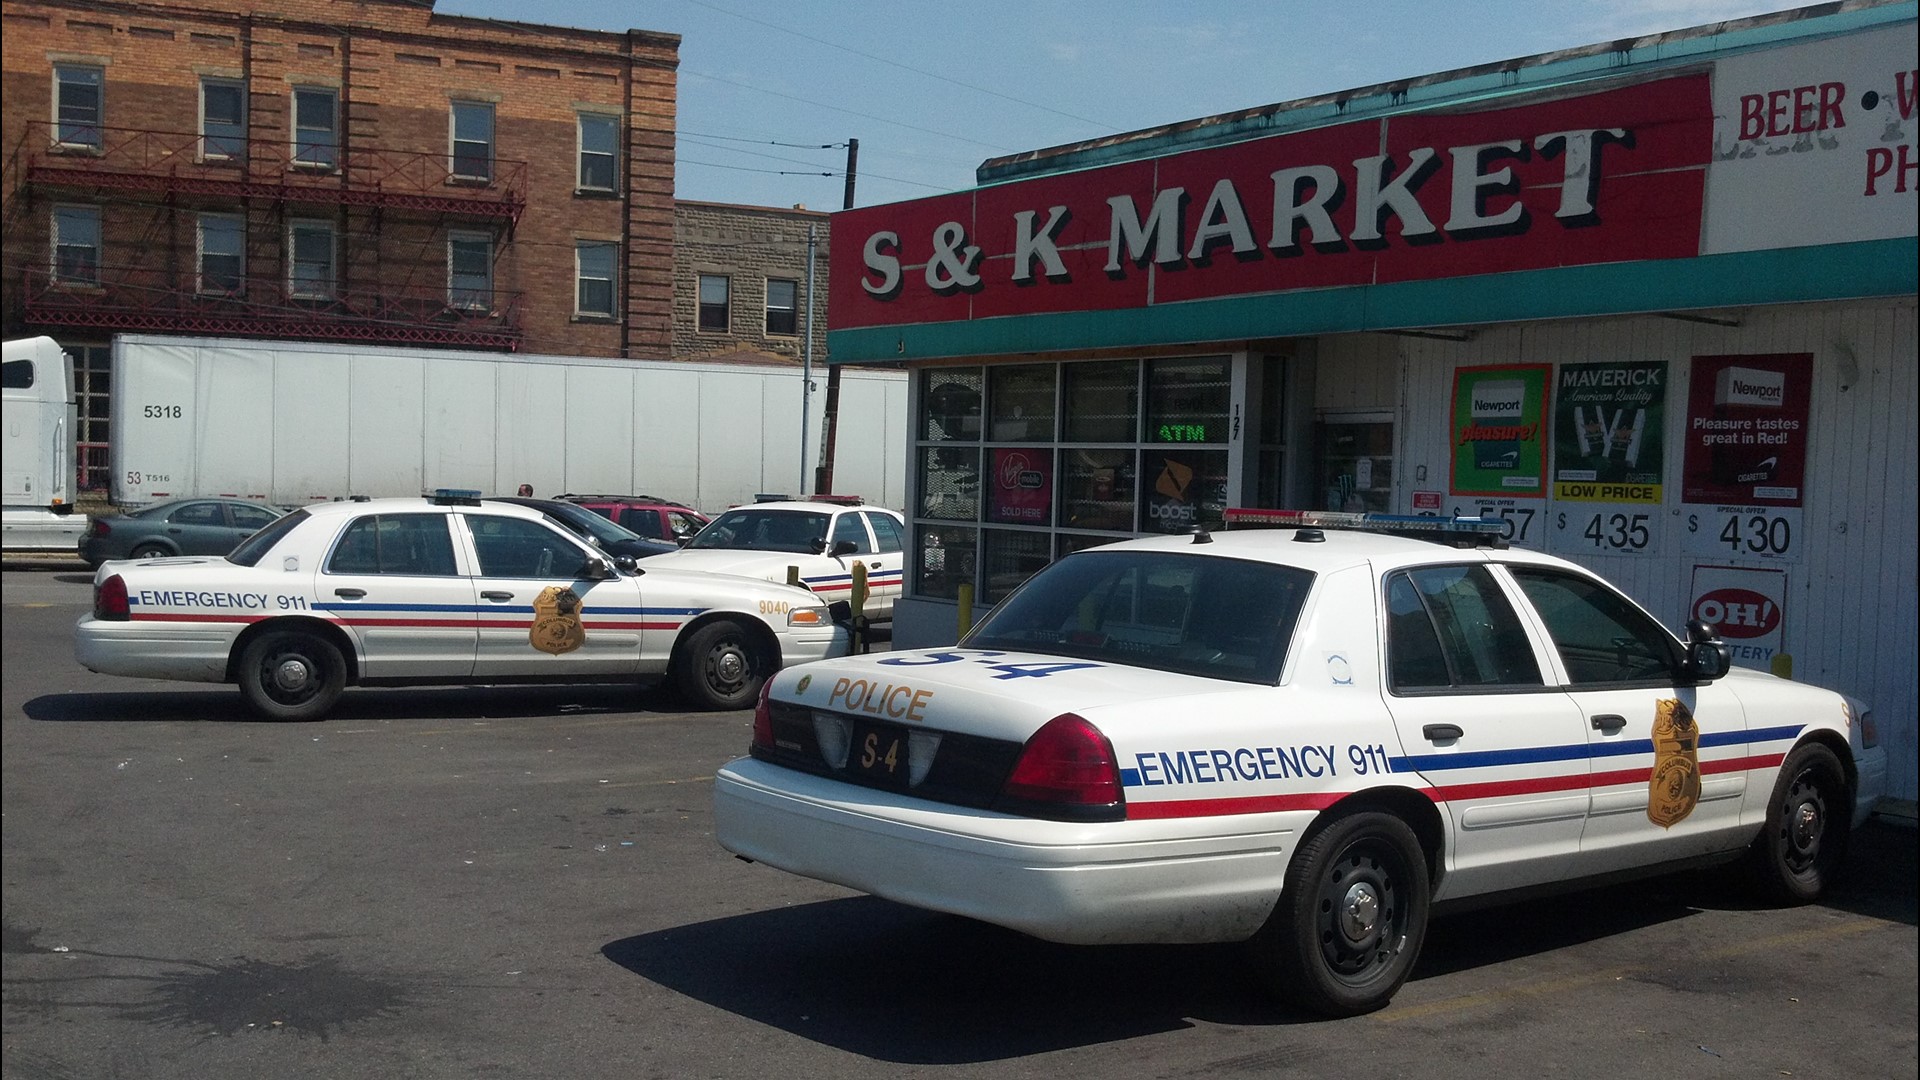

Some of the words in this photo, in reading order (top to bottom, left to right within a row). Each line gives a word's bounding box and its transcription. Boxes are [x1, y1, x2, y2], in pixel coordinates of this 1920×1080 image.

[1738, 81, 1846, 141] BEER
[861, 231, 902, 298] S
[925, 221, 984, 296] &
[1011, 205, 1072, 286] K
[1103, 128, 1636, 281] MARKET
[1562, 368, 1661, 387] MAVERICK
[1565, 389, 1613, 402] American
[1615, 388, 1652, 405] Quality
[1732, 380, 1781, 398] Newport
[144, 405, 182, 418] 5318
[1474, 399, 1520, 412] Newport
[1232, 404, 1241, 441] 127
[1693, 417, 1752, 430] Pleasure
[1756, 417, 1800, 430] tastes
[1159, 425, 1205, 441] ATM
[1459, 421, 1538, 446] pleasure!
[1703, 432, 1738, 446] great
[1742, 432, 1754, 444] in
[1757, 432, 1788, 444] Red!
[127, 471, 142, 485] 53
[145, 474, 170, 482] T516
[1561, 485, 1597, 498] LOW
[1601, 486, 1654, 499] PRICE
[1002, 506, 1021, 516] SOLD
[1022, 507, 1041, 517] HERE
[1149, 500, 1198, 520] boost
[1584, 513, 1649, 550] 4.35
[1688, 514, 1699, 534] $
[1720, 515, 1791, 555] 4.30
[140, 591, 268, 609] EMERGENCY
[277, 595, 307, 610] 911
[759, 600, 789, 615] 9040
[1698, 600, 1774, 628] OH!
[828, 677, 934, 722] POLICE
[861, 733, 899, 773] S-4
[1135, 744, 1337, 786] EMERGENCY
[1349, 743, 1393, 776] 911
